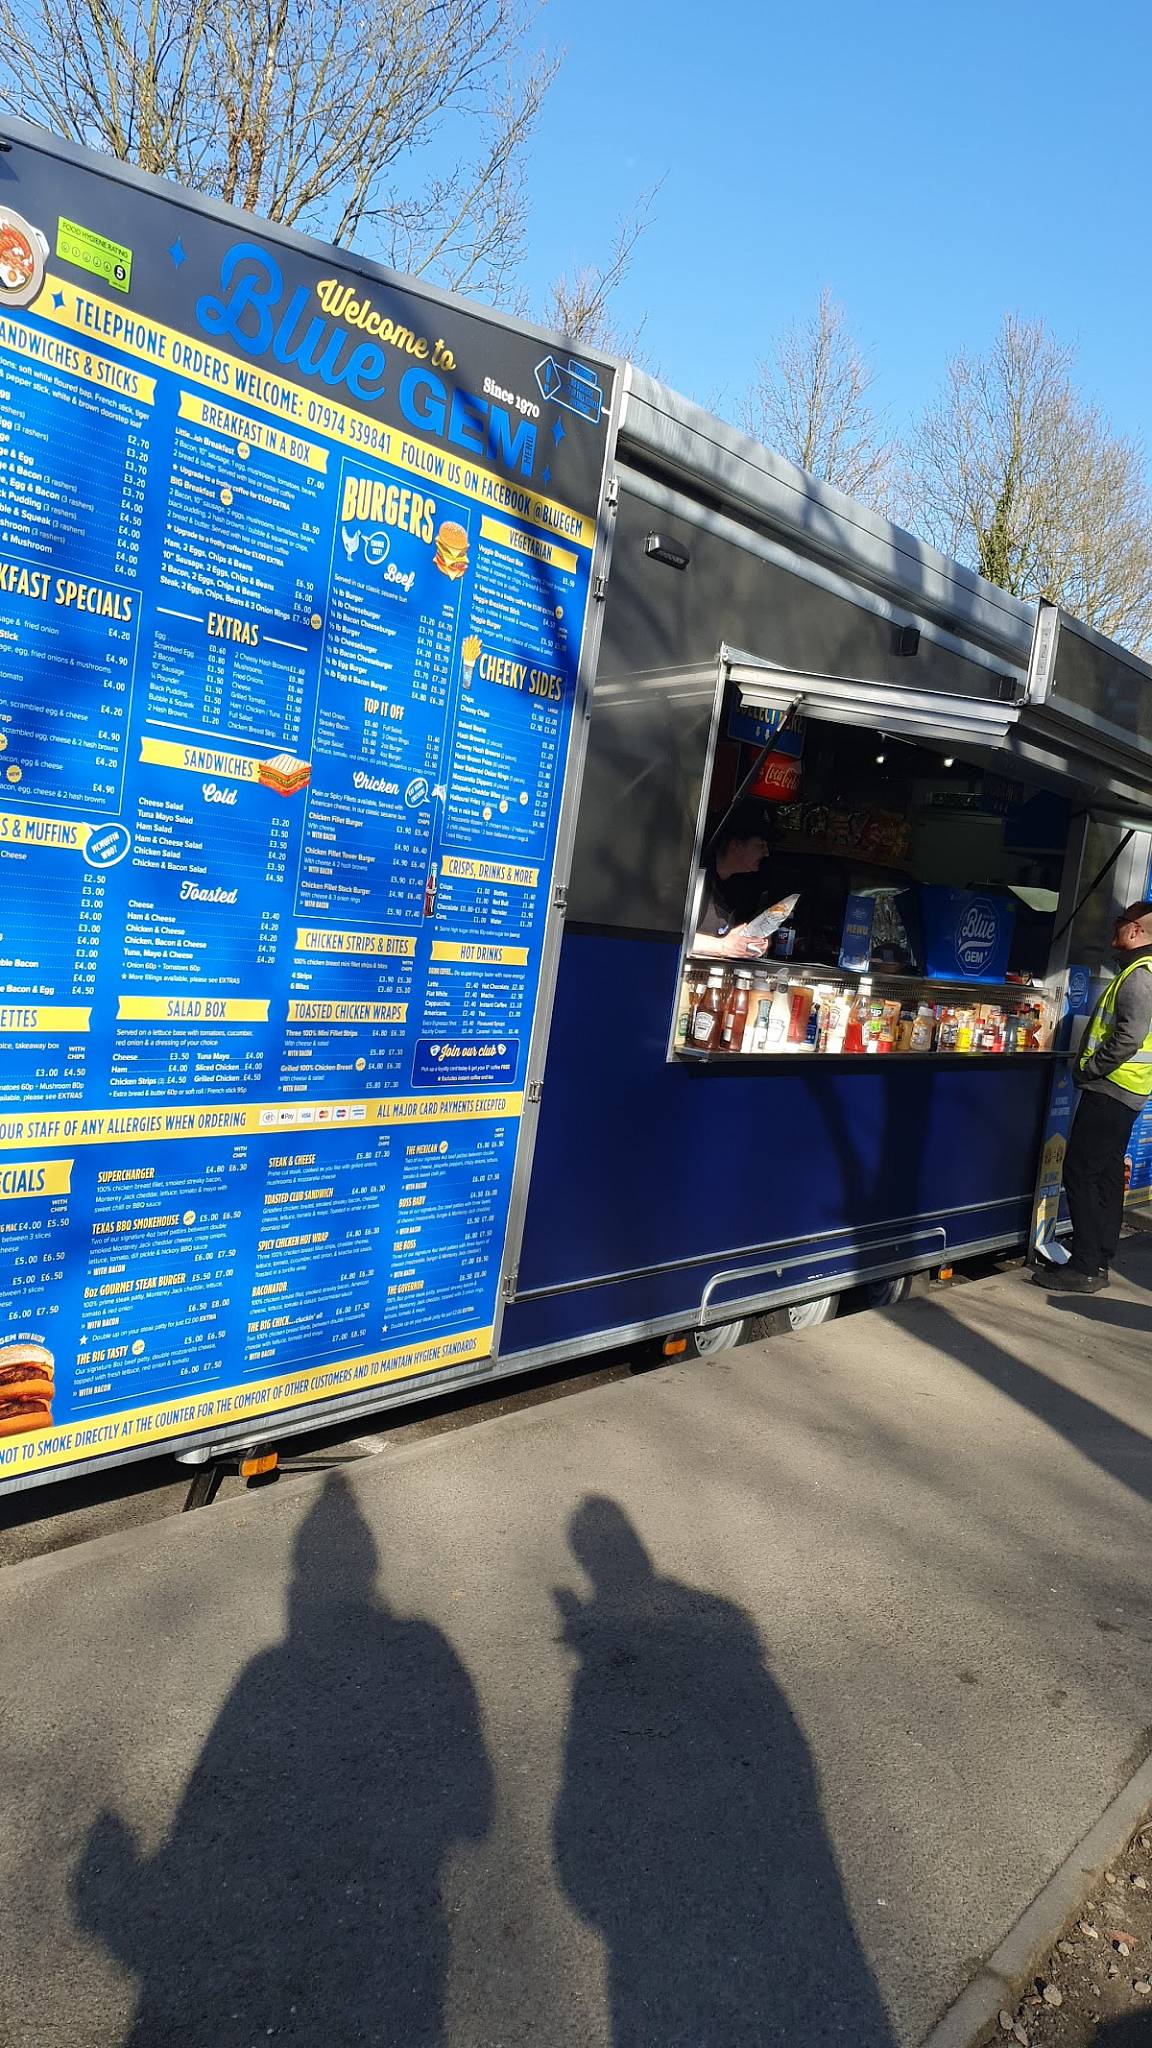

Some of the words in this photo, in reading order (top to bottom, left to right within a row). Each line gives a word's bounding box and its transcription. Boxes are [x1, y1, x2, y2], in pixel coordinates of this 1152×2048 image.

[62, 222, 82, 236] FOOD
[108, 243, 129, 259] RATING
[317, 279, 428, 359] Welcome
[432, 340, 456, 372] to
[195, 242, 386, 401] Blue
[399, 366, 538, 478] GEM
[84, 356, 92, 377] &
[97, 361, 139, 394] STICKS
[483, 376, 514, 404] Since
[516, 396, 540, 419] 1970
[75, 297, 166, 359] TELEPHONE
[172, 341, 230, 385] ORDERS
[234, 368, 304, 418] WELCOME:
[308, 402, 345, 435] 07974
[350, 418, 391, 455] 539841
[401, 441, 443, 478] FOLLOW
[448, 462, 461, 485] US
[465, 470, 479, 494] ON
[482, 476, 531, 517] FACEBOOK
[534, 500, 583, 538] @BLUEGEM
[128, 435, 150, 450] £2.70
[201, 404, 262, 442] BREAKFAST
[265, 430, 276, 447] IN
[279, 437, 287, 454] A
[290, 441, 311, 463] BOX
[126, 448, 148, 463] £3.20
[522, 435, 534, 468] MENU
[125, 461, 147, 476] £3.70
[184, 481, 216, 499] Breakfast
[35, 486, 60, 501] Bacon
[69, 498, 94, 512] rashers)
[120, 513, 142, 527] £4.50
[341, 476, 436, 544] BURGERS
[21, 510, 51, 526] Squeak
[60, 523, 85, 537] rashers)
[10, 534, 53, 554] Mushroom
[114, 564, 136, 578] £4.00
[509, 530, 553, 562] VEGETARIAN
[383, 563, 415, 592] Beef
[55, 578, 133, 622] SPECIALS
[108, 628, 131, 641] £4.20
[207, 611, 259, 647] EXTRAS
[106, 653, 128, 666] £4.90
[479, 653, 528, 691] CHEEKY
[529, 669, 562, 701] SIDES
[10, 700, 45, 714] scrambled
[364, 697, 379, 714] TOP
[381, 701, 389, 717] IT
[390, 704, 405, 721] OFF
[184, 749, 254, 777] SANDWICHES
[353, 771, 400, 795] Chicken
[138, 797, 164, 809] Cheese
[165, 801, 184, 811] Salad
[202, 783, 238, 806] Cold
[138, 809, 154, 819] Tuna
[155, 812, 174, 823] Mayo
[175, 815, 193, 825] Salad
[12, 819, 21, 838] &
[25, 820, 77, 844] MUFFINS
[83, 873, 106, 884] £2.50
[132, 858, 160, 869] Chicken
[167, 862, 187, 872] Bacon
[189, 864, 207, 874] Salad
[266, 874, 284, 883] £4.50
[448, 859, 476, 879] CRISPS,
[478, 863, 505, 880] DRINKS
[513, 868, 533, 883] MORE
[180, 881, 238, 904] Toasted
[127, 911, 143, 921] Ham
[151, 914, 176, 924] Cheese
[962, 907, 995, 939] Blue
[305, 932, 344, 950] CHICKEN
[346, 936, 375, 952] STRIPS
[377, 938, 384, 952] &
[386, 938, 408, 954] BITES
[461, 945, 475, 959] HOT
[476, 946, 503, 961] DRINKS
[964, 950, 983, 963] GEM
[0, 1009, 38, 1028] ETTES
[167, 1000, 201, 1017] SALAD
[205, 1001, 226, 1018] BOX
[294, 1003, 332, 1019] TOASTED
[335, 1004, 373, 1020] CHICKEN
[373, 1005, 402, 1020] WRAPS
[438, 1044, 461, 1061] Join
[462, 1047, 477, 1057] our
[478, 1045, 497, 1057] club
[195, 1064, 214, 1072] Sliced
[377, 1106, 390, 1118] ALL
[393, 1103, 417, 1117] MAJOR
[420, 1102, 438, 1115] CARD
[440, 1099, 474, 1113] PAYMENTS
[476, 1098, 506, 1111] EXCEPTED
[0, 1122, 24, 1140] OUR
[27, 1120, 60, 1138] STAFF
[64, 1120, 78, 1137] OF
[81, 1118, 104, 1135] ANY
[107, 1114, 162, 1134] ALLERGIES
[165, 1113, 195, 1130] WHEN
[198, 1112, 247, 1128] ORDERING
[406, 1145, 415, 1155] THE
[416, 1143, 438, 1154] MEXICAN
[268, 1156, 287, 1168] STEAK
[294, 1153, 316, 1165] CHEESE
[97, 1167, 155, 1183] SUPERCHARGER
[264, 1193, 289, 1205] TOASTED
[290, 1191, 304, 1203] CLUB
[304, 1187, 334, 1200] SANDWICH
[18, 1220, 42, 1231] £4.00
[47, 1218, 70, 1229] £5.50
[92, 1221, 114, 1235] TEXAS
[116, 1219, 132, 1232] BBQ
[133, 1214, 180, 1231] SMOKEHOUSE
[100, 1280, 134, 1297] GOURMET
[135, 1276, 157, 1291] STEAK
[159, 1272, 186, 1287] BURGER
[252, 1281, 288, 1297] BACONATOR
[387, 1285, 397, 1296] THE
[398, 1280, 425, 1294] GOVERNOR
[8, 1310, 32, 1320] £6.00
[36, 1305, 59, 1317] £7.50
[76, 1353, 91, 1366] THE
[92, 1351, 105, 1362] BIG
[107, 1346, 128, 1360] TASTY
[0, 1446, 19, 1465] NOT
[22, 1444, 35, 1462] TO
[37, 1436, 72, 1457] SMOKE
[75, 1423, 120, 1447] DIRECTLY
[122, 1421, 133, 1438] AT
[136, 1416, 152, 1435] THE
[155, 1406, 195, 1431] COUNTER
[197, 1401, 215, 1421] FOR
[217, 1396, 233, 1415] THE
[234, 1390, 271, 1410] COMFORT
[273, 1384, 283, 1399] OF
[284, 1379, 309, 1397] OTHER
[311, 1368, 352, 1391] CUSTOMERS
[353, 1365, 369, 1380] AND
[371, 1361, 379, 1374] TO
[381, 1353, 413, 1373] MAINTAIN
[415, 1346, 441, 1366] HYGIENE
[442, 1338, 477, 1358] STANDARDS
